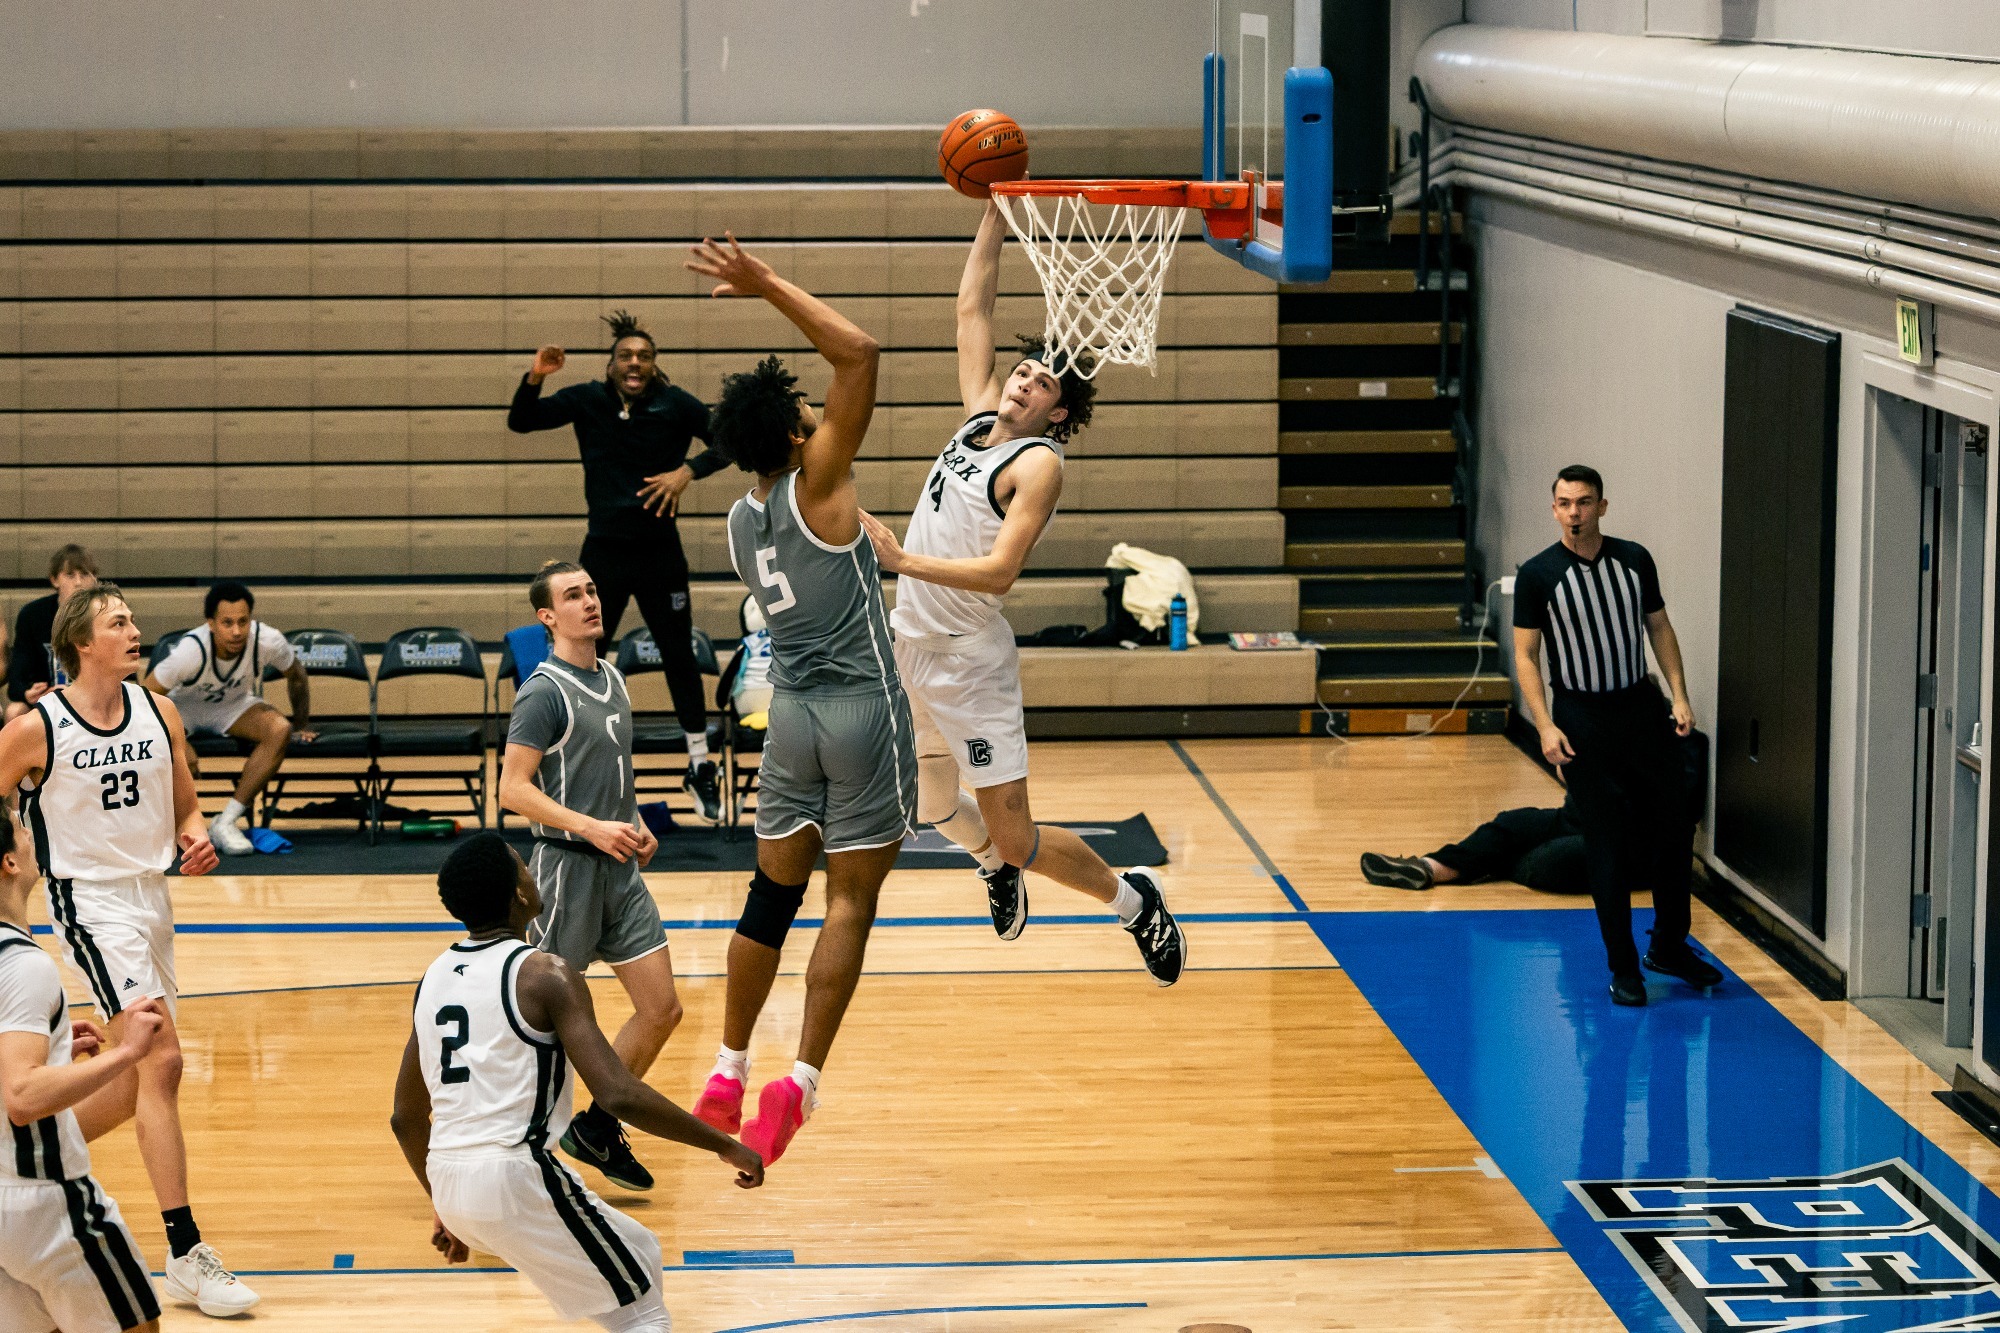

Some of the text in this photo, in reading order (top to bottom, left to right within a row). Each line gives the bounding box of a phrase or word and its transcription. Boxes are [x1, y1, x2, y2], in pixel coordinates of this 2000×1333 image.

[1901, 305, 1917, 356] EXIT
[755, 545, 797, 616] 5
[72, 739, 154, 770] CLARK
[100, 769, 140, 811] 23
[435, 1004, 471, 1085] 2
